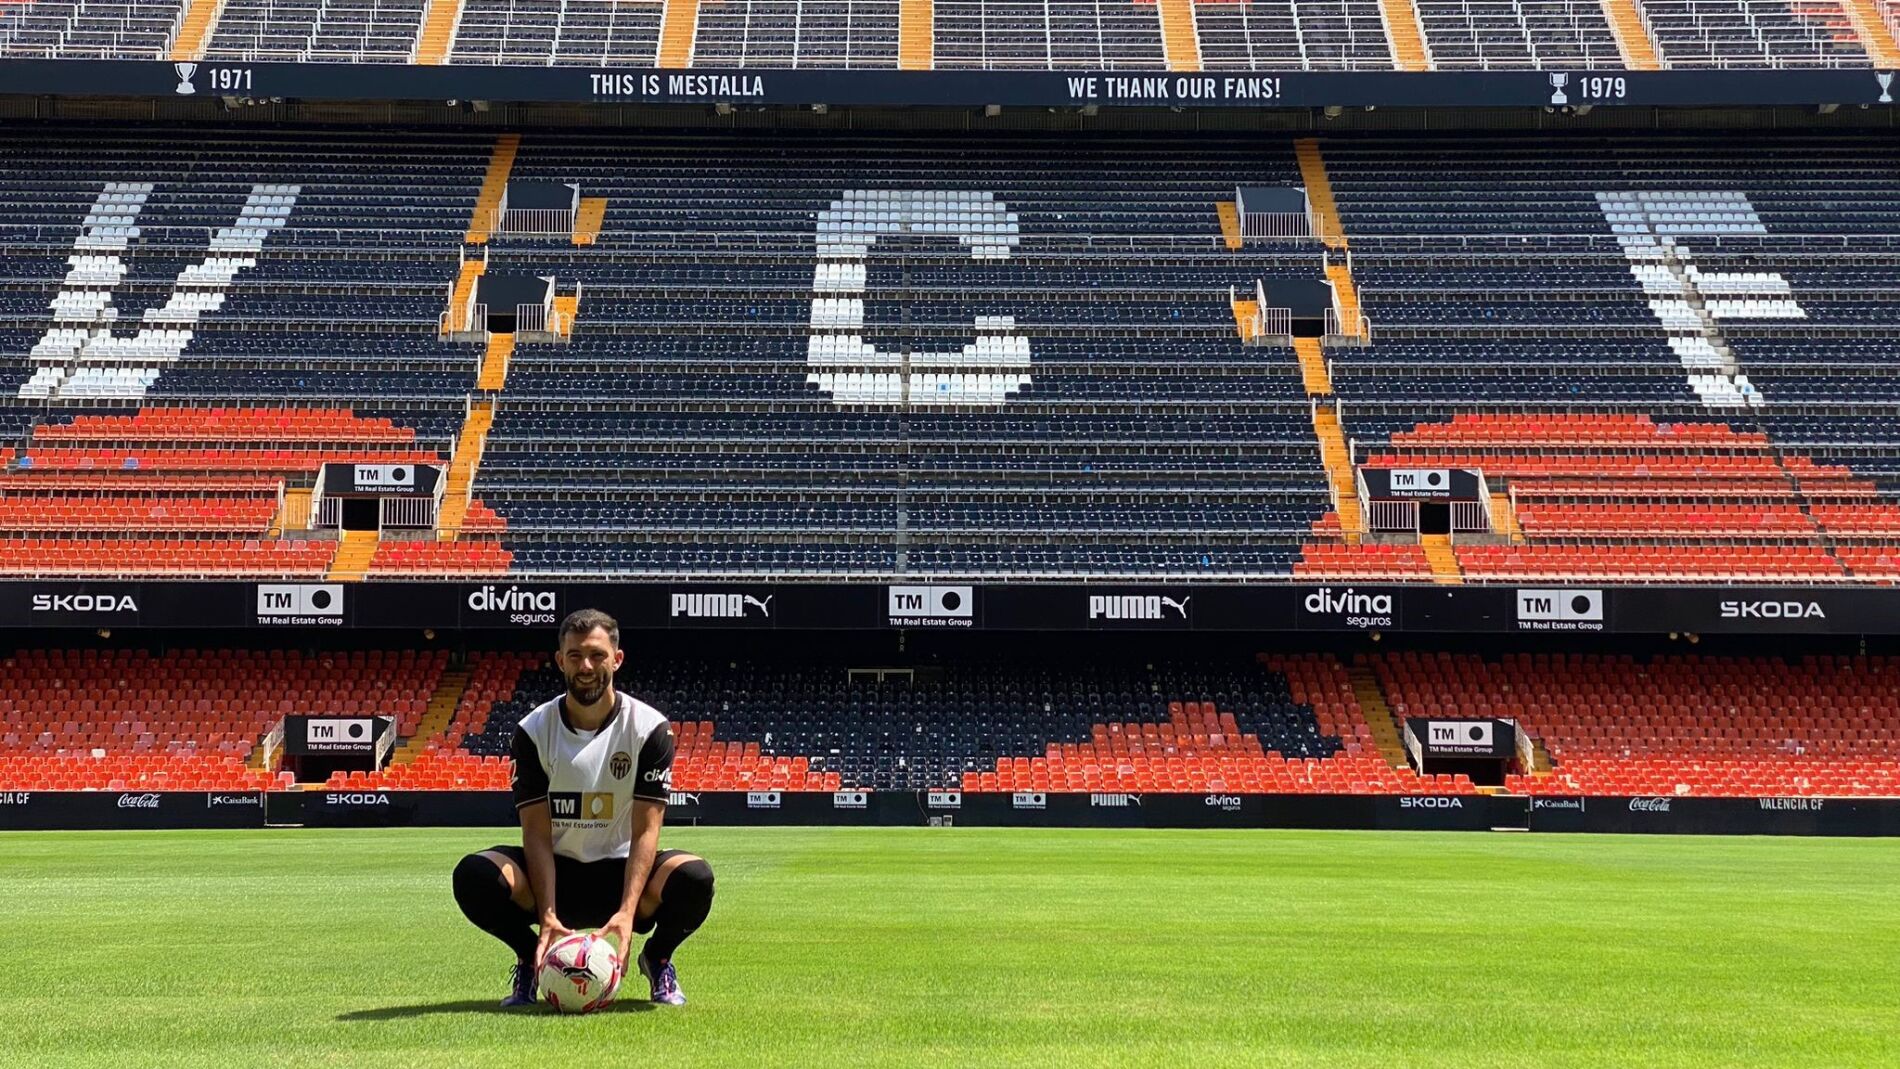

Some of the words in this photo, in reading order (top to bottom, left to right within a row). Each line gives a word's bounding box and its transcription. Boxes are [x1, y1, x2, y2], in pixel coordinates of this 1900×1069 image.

[210, 69, 251, 89] 1971
[591, 74, 633, 94] THIS
[643, 75, 659, 95] IS
[669, 75, 763, 95] MESTALLA
[1068, 78, 1097, 97] WE
[1105, 78, 1168, 98] THANK
[1177, 78, 1215, 98] OUR
[1225, 78, 1280, 98] FANS!
[1581, 78, 1625, 97] 1979
[359, 470, 378, 480] TM
[1395, 475, 1414, 485] TM
[354, 485, 364, 493] TM
[264, 593, 291, 608] TM
[469, 586, 555, 610] divina
[895, 595, 921, 609] TM
[1305, 588, 1391, 613] divina
[672, 594, 742, 617] PUMA
[1090, 596, 1160, 618] PUMA
[1523, 598, 1551, 613] TM
[318, 617, 342, 625] Group
[511, 614, 555, 625] seguros
[948, 619, 972, 627] Group
[1347, 617, 1391, 628] seguros
[1578, 622, 1603, 631] Group
[312, 726, 333, 737] TM
[1433, 728, 1454, 739] TM
[17, 793, 30, 804] CF
[1091, 794, 1127, 806] PUMA
[1205, 795, 1240, 805] divina
[1545, 800, 1579, 808] CaixaBank
[1760, 798, 1807, 809] VALENCIA
[1811, 799, 1823, 810] CF
[553, 799, 575, 814] TM
